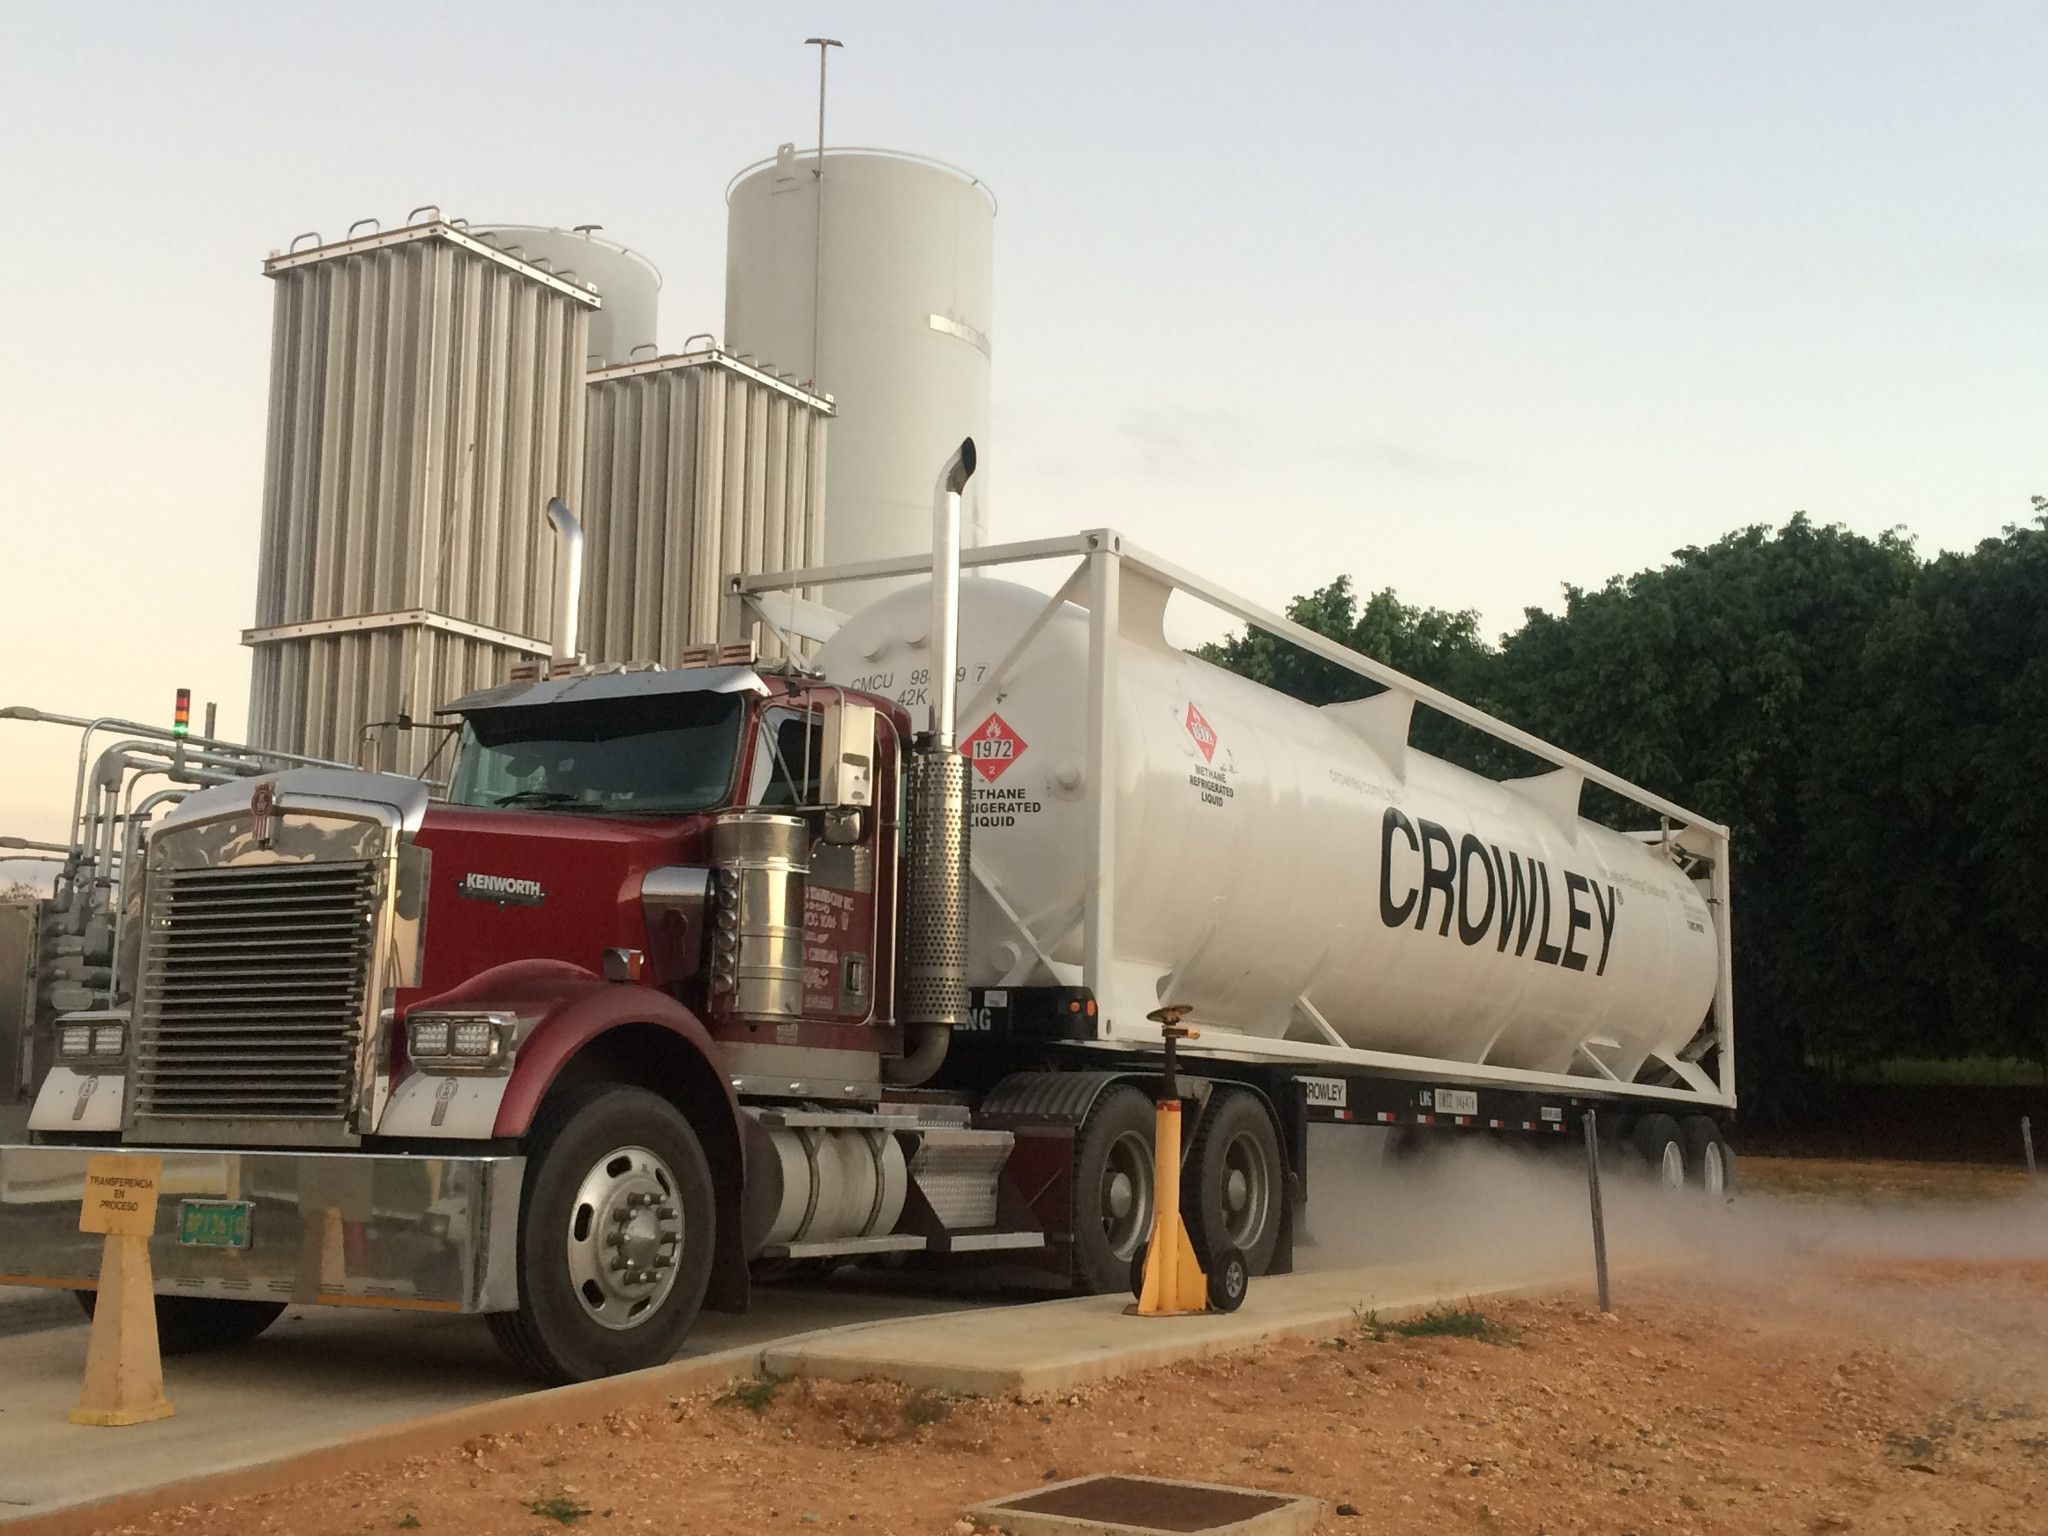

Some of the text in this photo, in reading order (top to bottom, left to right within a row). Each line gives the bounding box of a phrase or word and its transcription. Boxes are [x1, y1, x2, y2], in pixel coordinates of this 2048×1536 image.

[851, 672, 894, 692] CMCU
[976, 666, 987, 682] 7
[974, 740, 1012, 758] 1972
[988, 765, 996, 775] 2
[1195, 764, 1227, 784] METHANE
[970, 788, 1026, 800] ETHANE
[1189, 774, 1234, 798] REFRIGERATED
[1201, 792, 1224, 808] LIQUID
[466, 872, 541, 896] KENWORTH
[1379, 806, 1615, 977] CROWLEY
[1307, 1081, 1344, 1102] ROWLEY
[89, 1175, 153, 1189] TRANSFERENCIA
[113, 1189, 125, 1199] EN
[99, 1201, 139, 1212] PROCESO
